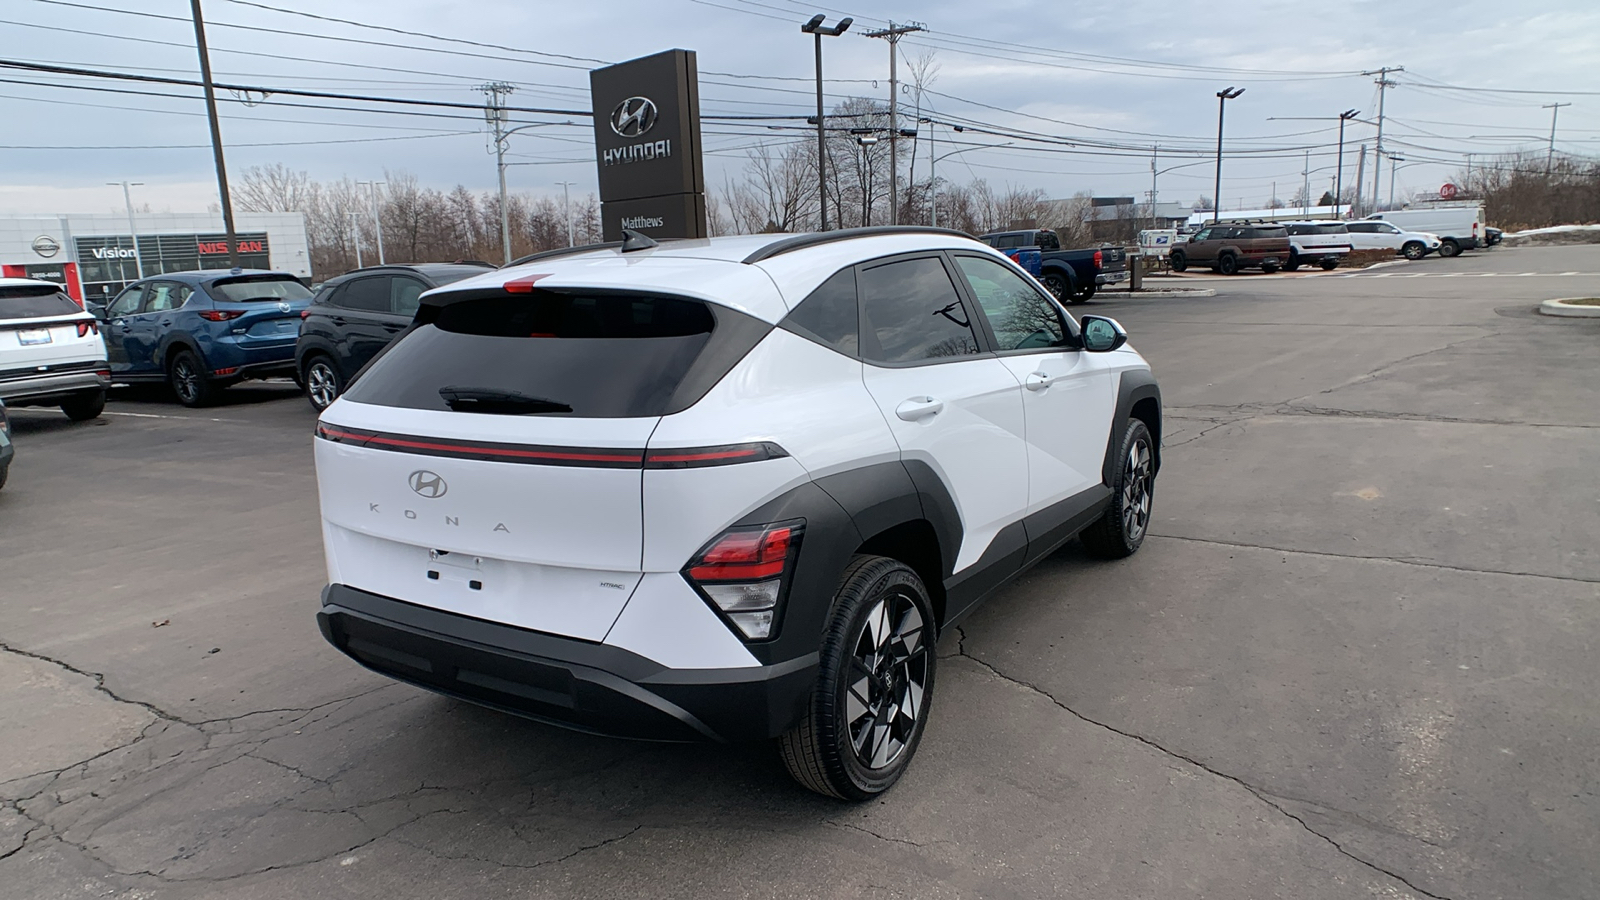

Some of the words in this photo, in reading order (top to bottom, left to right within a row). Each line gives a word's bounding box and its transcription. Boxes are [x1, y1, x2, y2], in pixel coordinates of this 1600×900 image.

[603, 139, 671, 166] HYUNDAI
[622, 216, 663, 229] Matthews
[92, 247, 137, 259] Vision
[198, 241, 262, 254] NISAN
[369, 502, 510, 533] KONA
